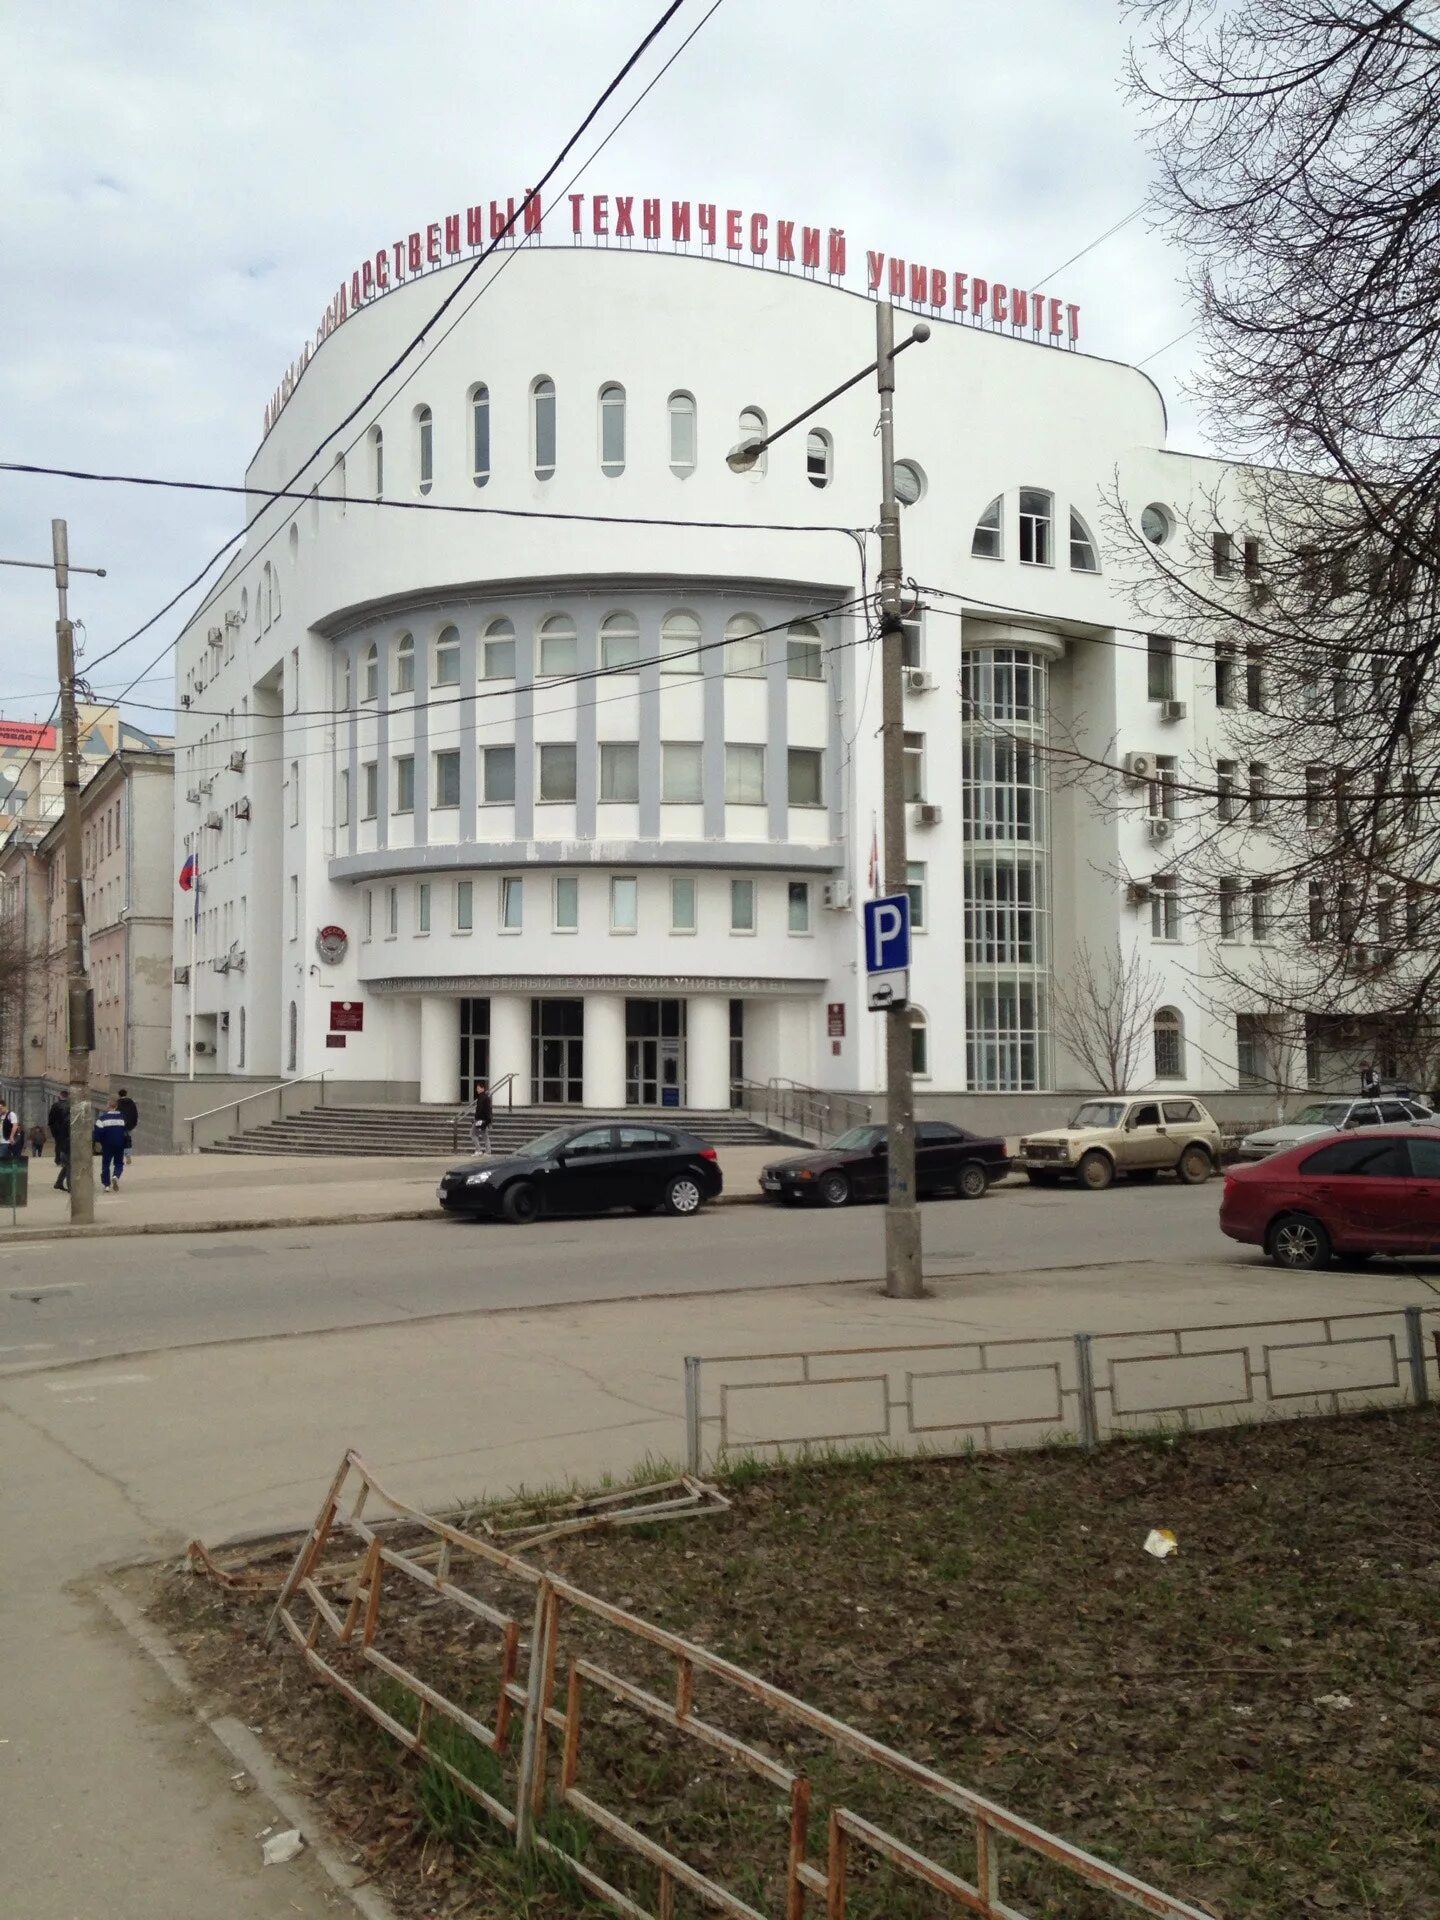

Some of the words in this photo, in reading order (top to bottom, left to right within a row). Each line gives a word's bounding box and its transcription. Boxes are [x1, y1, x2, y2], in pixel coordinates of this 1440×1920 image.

[567, 193, 847, 275] ТЕХНИЧЕСКИЙ
[866, 250, 1081, 341] УНИВЕРСИТЕТ
[873, 904, 902, 967] P
